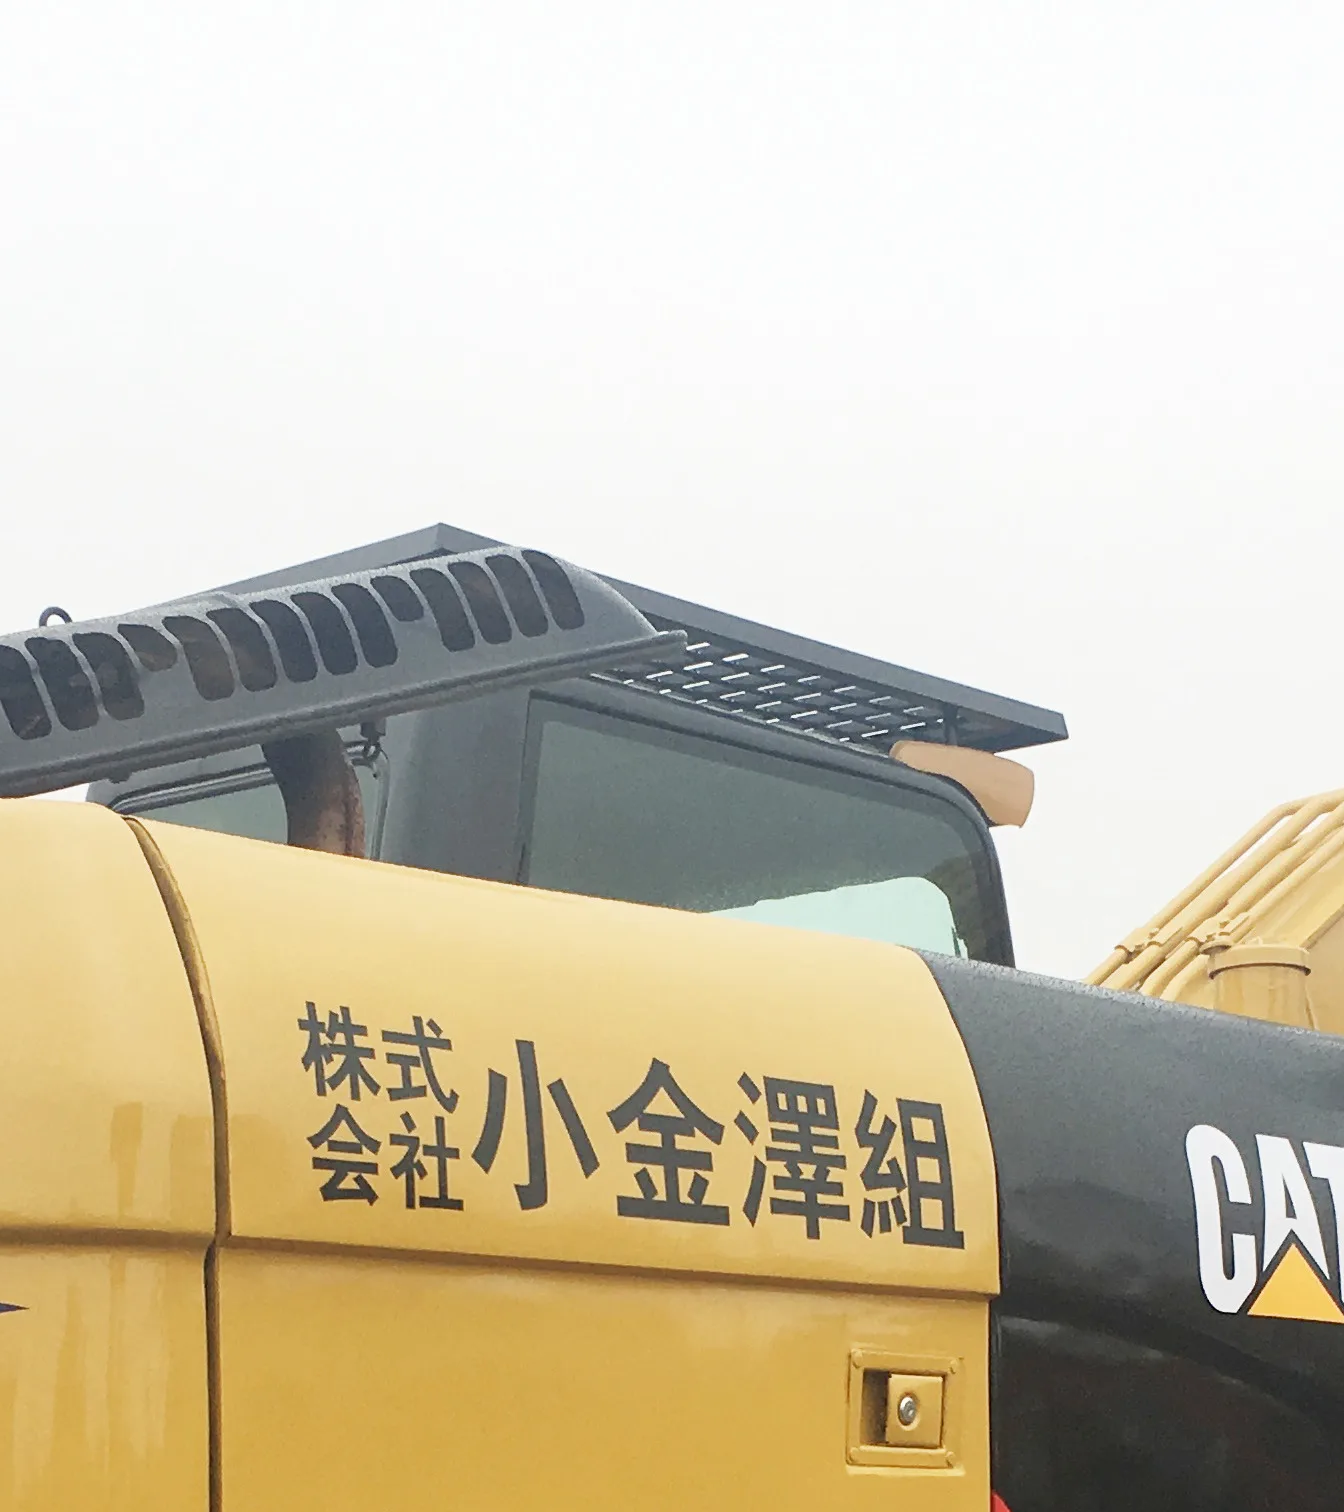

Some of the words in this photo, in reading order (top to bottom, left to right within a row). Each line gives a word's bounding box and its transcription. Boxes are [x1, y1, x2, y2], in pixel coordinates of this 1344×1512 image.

[297, 1000, 460, 1113] 株式
[306, 1102, 464, 1212] 会社
[470, 1038, 966, 1250] 小金澤組
